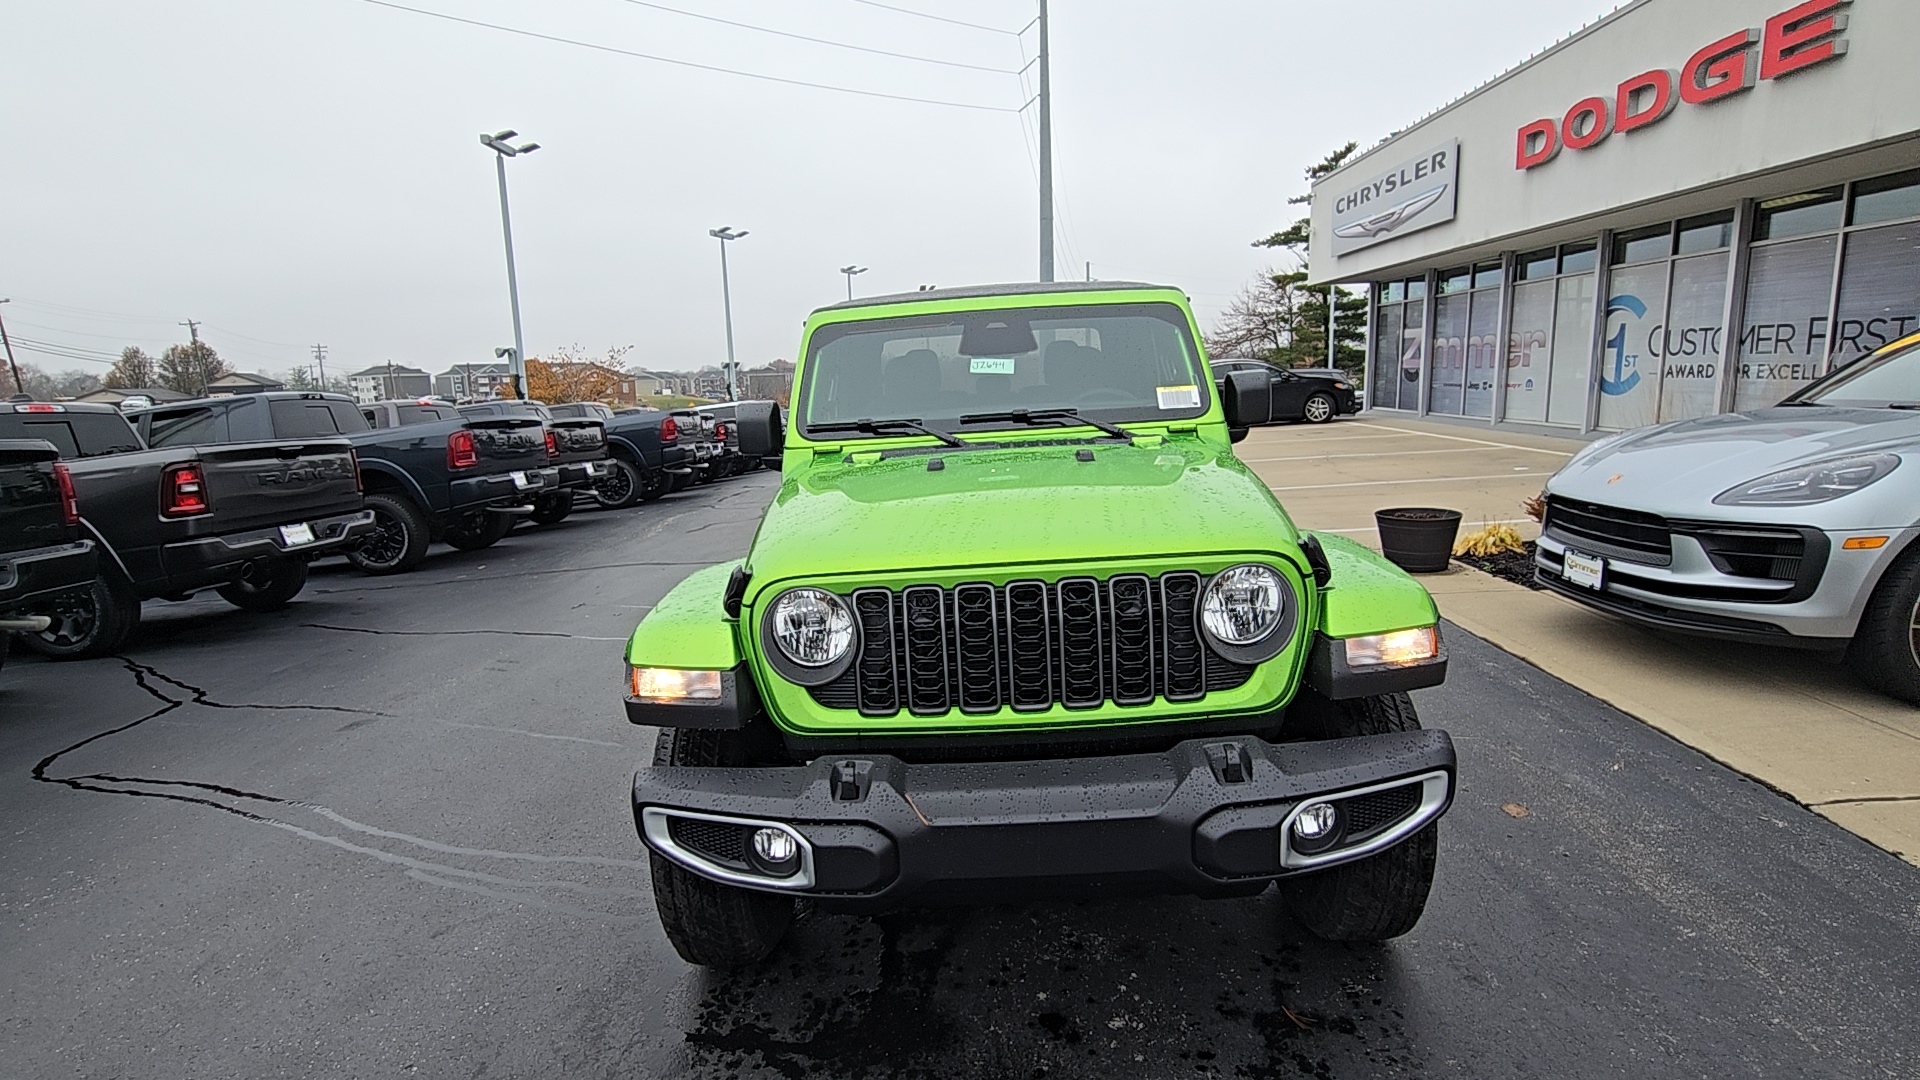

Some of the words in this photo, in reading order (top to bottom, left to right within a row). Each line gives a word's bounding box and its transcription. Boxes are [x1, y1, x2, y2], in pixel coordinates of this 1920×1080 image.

[1515, 0, 1846, 171] DODGE
[1335, 150, 1447, 215] CHRYSLER
[1402, 328, 1547, 369] Zmmer
[1665, 363, 1716, 379] AWARD
